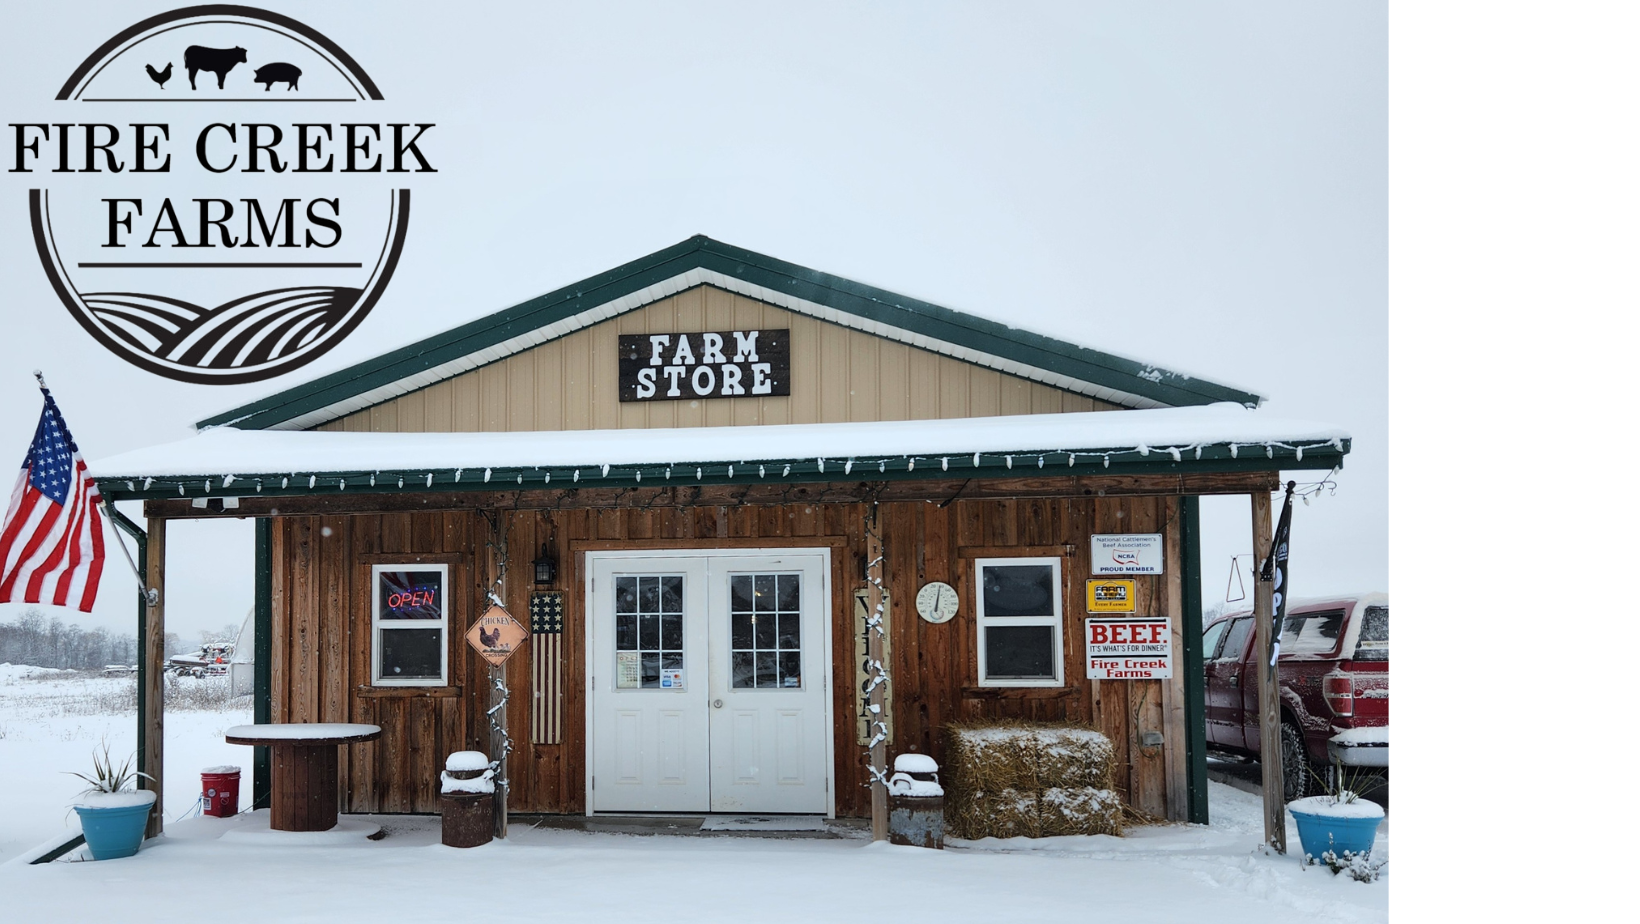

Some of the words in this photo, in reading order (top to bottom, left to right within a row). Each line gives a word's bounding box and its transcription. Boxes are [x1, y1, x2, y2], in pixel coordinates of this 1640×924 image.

[650, 331, 759, 366] FARM
[637, 363, 772, 398] STORE
[388, 590, 435, 608] OPEN
[481, 616, 510, 626] CHICKEN
[1090, 624, 1167, 644] BEEF.
[1091, 660, 1119, 669] Fire
[1124, 659, 1167, 669] Creek
[1107, 669, 1152, 678] Farms
